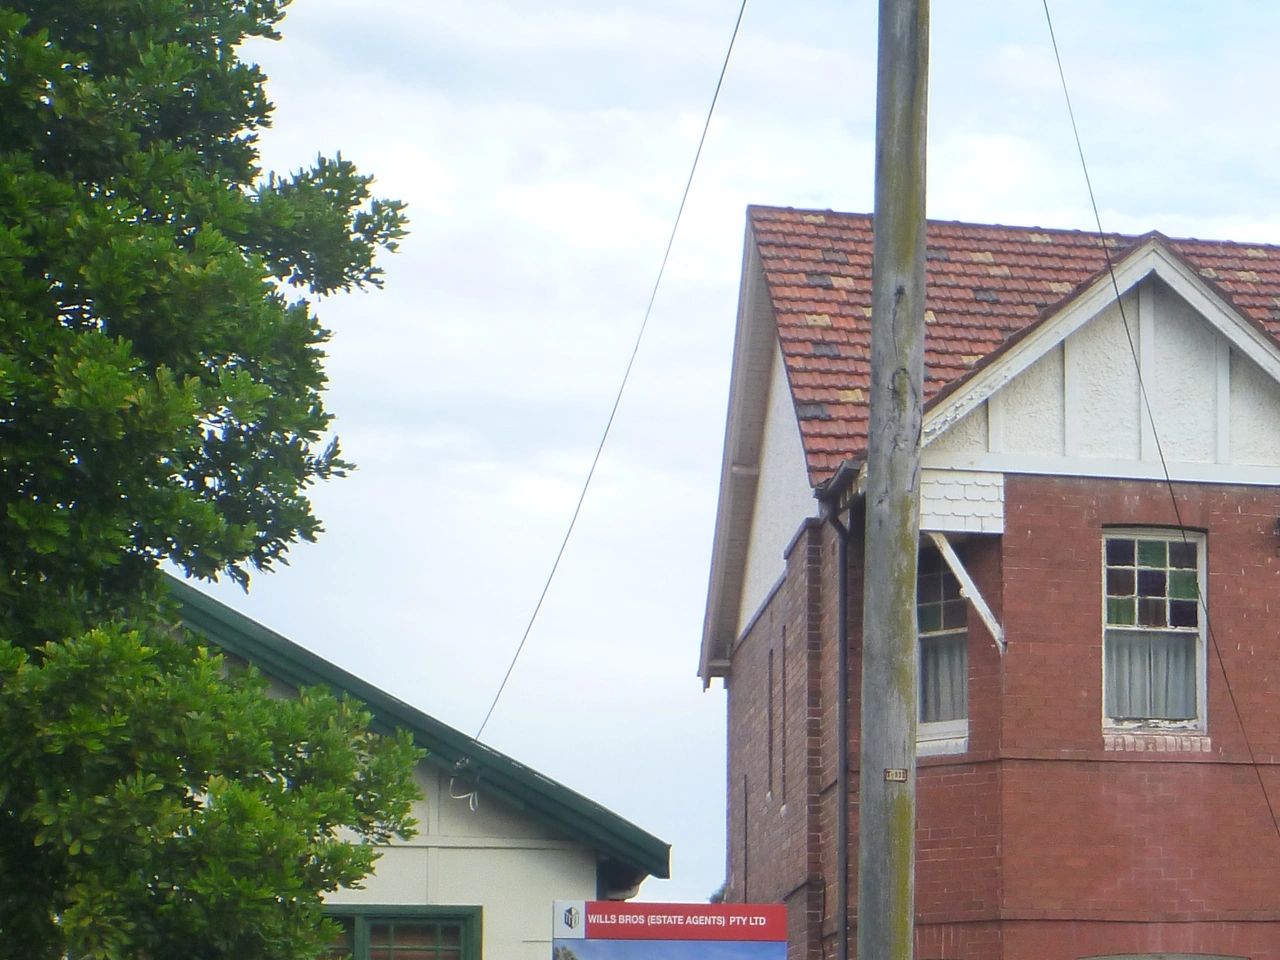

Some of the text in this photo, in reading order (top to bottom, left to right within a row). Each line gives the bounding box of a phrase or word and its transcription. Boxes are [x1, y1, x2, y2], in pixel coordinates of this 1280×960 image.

[588, 915, 766, 926] WILLS BROS (ESTATE AGENTS) PTY LTD
